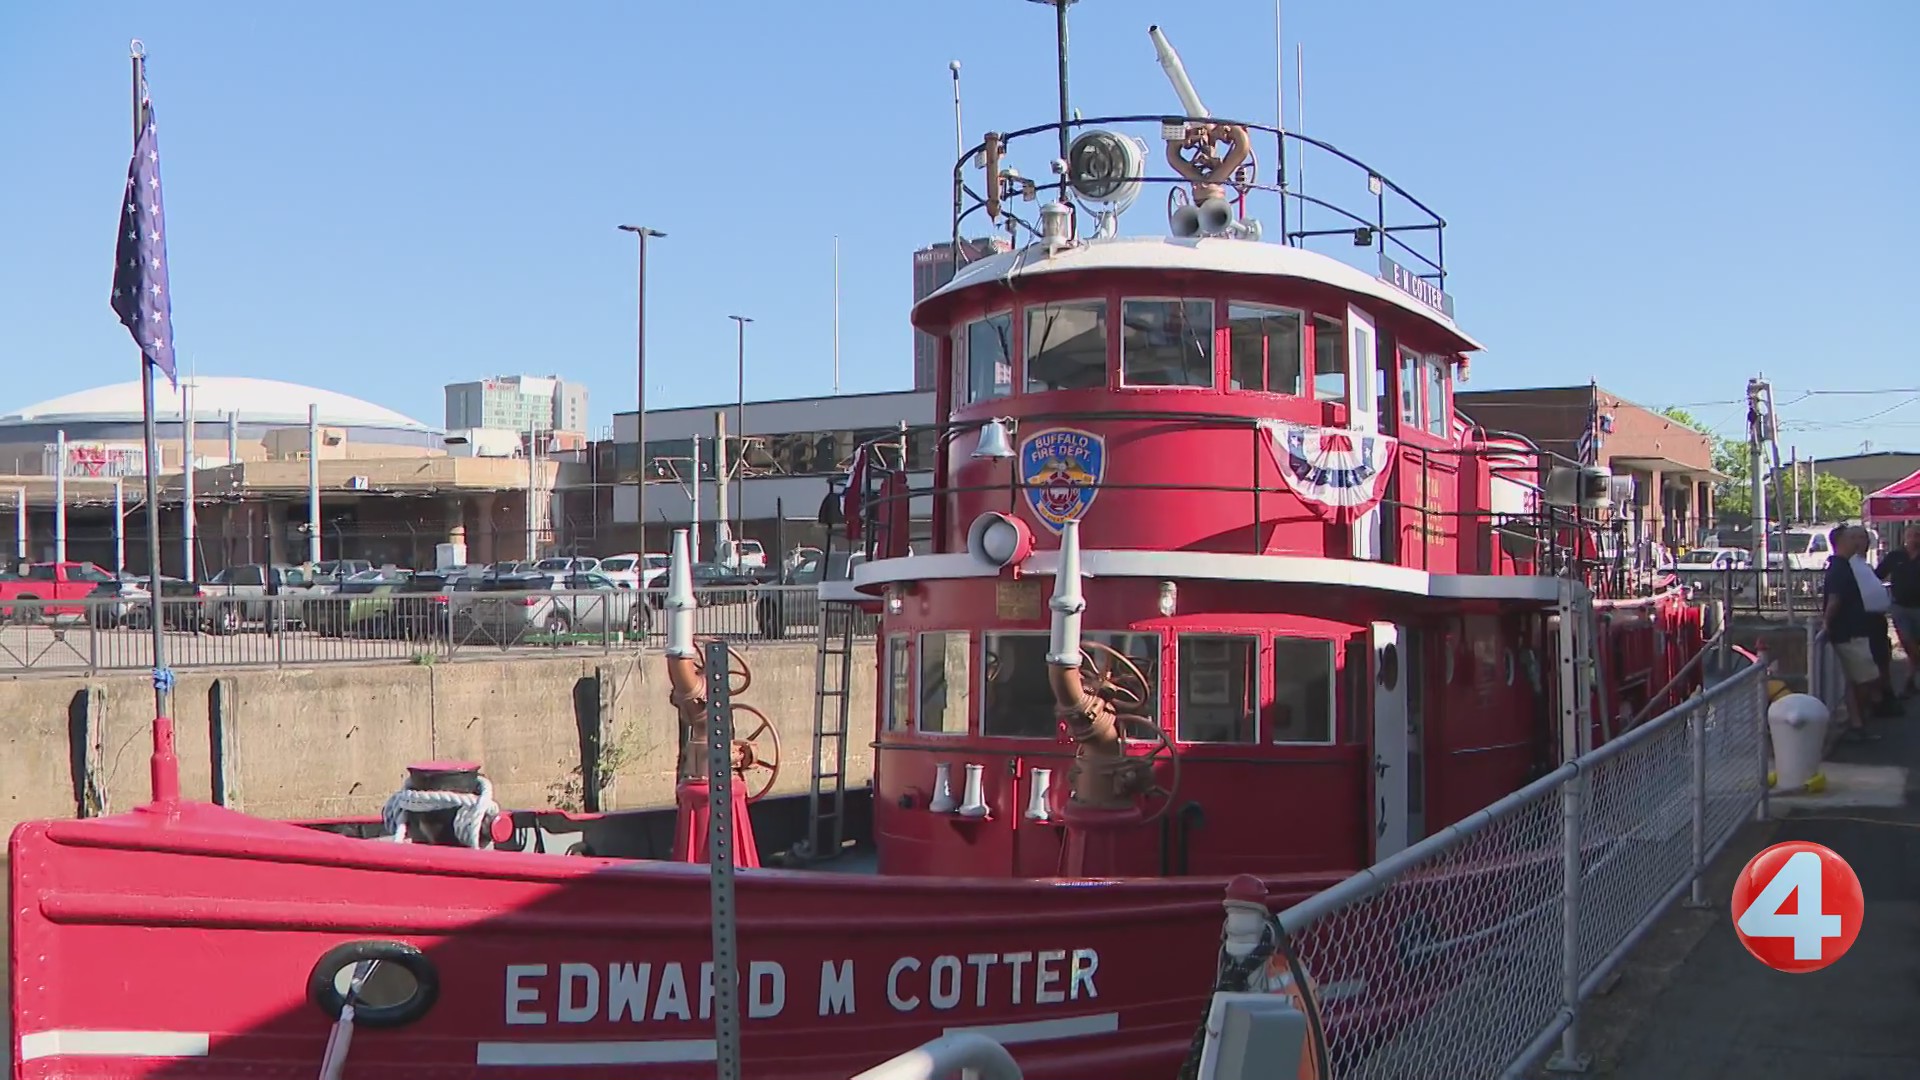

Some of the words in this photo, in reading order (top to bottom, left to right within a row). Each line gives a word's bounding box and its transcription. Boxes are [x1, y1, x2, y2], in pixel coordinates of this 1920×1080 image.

[1394, 263, 1400, 286] E
[1412, 276, 1442, 310] COTTER
[1031, 445, 1056, 462] FIRE
[1035, 434, 1088, 448] BUFFALO
[818, 959, 856, 1016] M
[887, 948, 1099, 1011] COTTER
